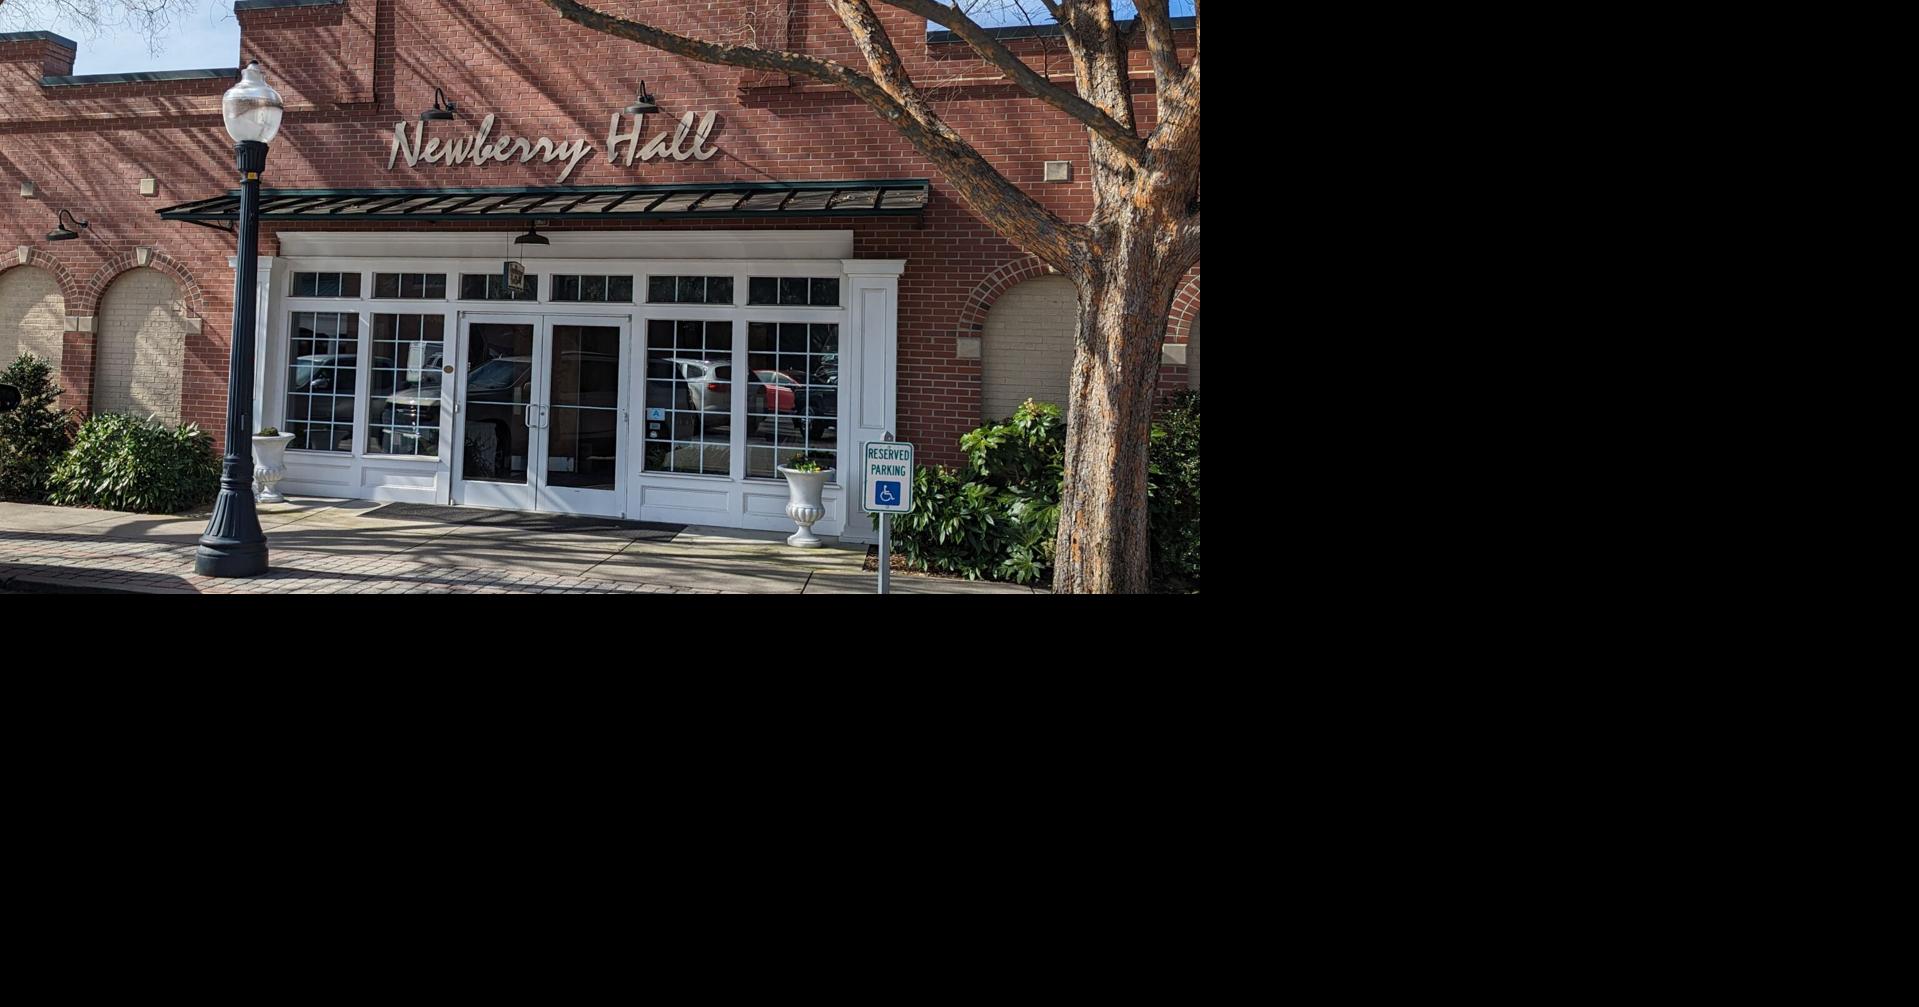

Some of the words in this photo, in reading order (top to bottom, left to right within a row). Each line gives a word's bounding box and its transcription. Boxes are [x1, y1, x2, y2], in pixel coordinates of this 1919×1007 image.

[388, 113, 591, 183] Newberry
[607, 111, 719, 167] Hall
[868, 448, 910, 461] RESERVED
[871, 464, 906, 477] PARKING
